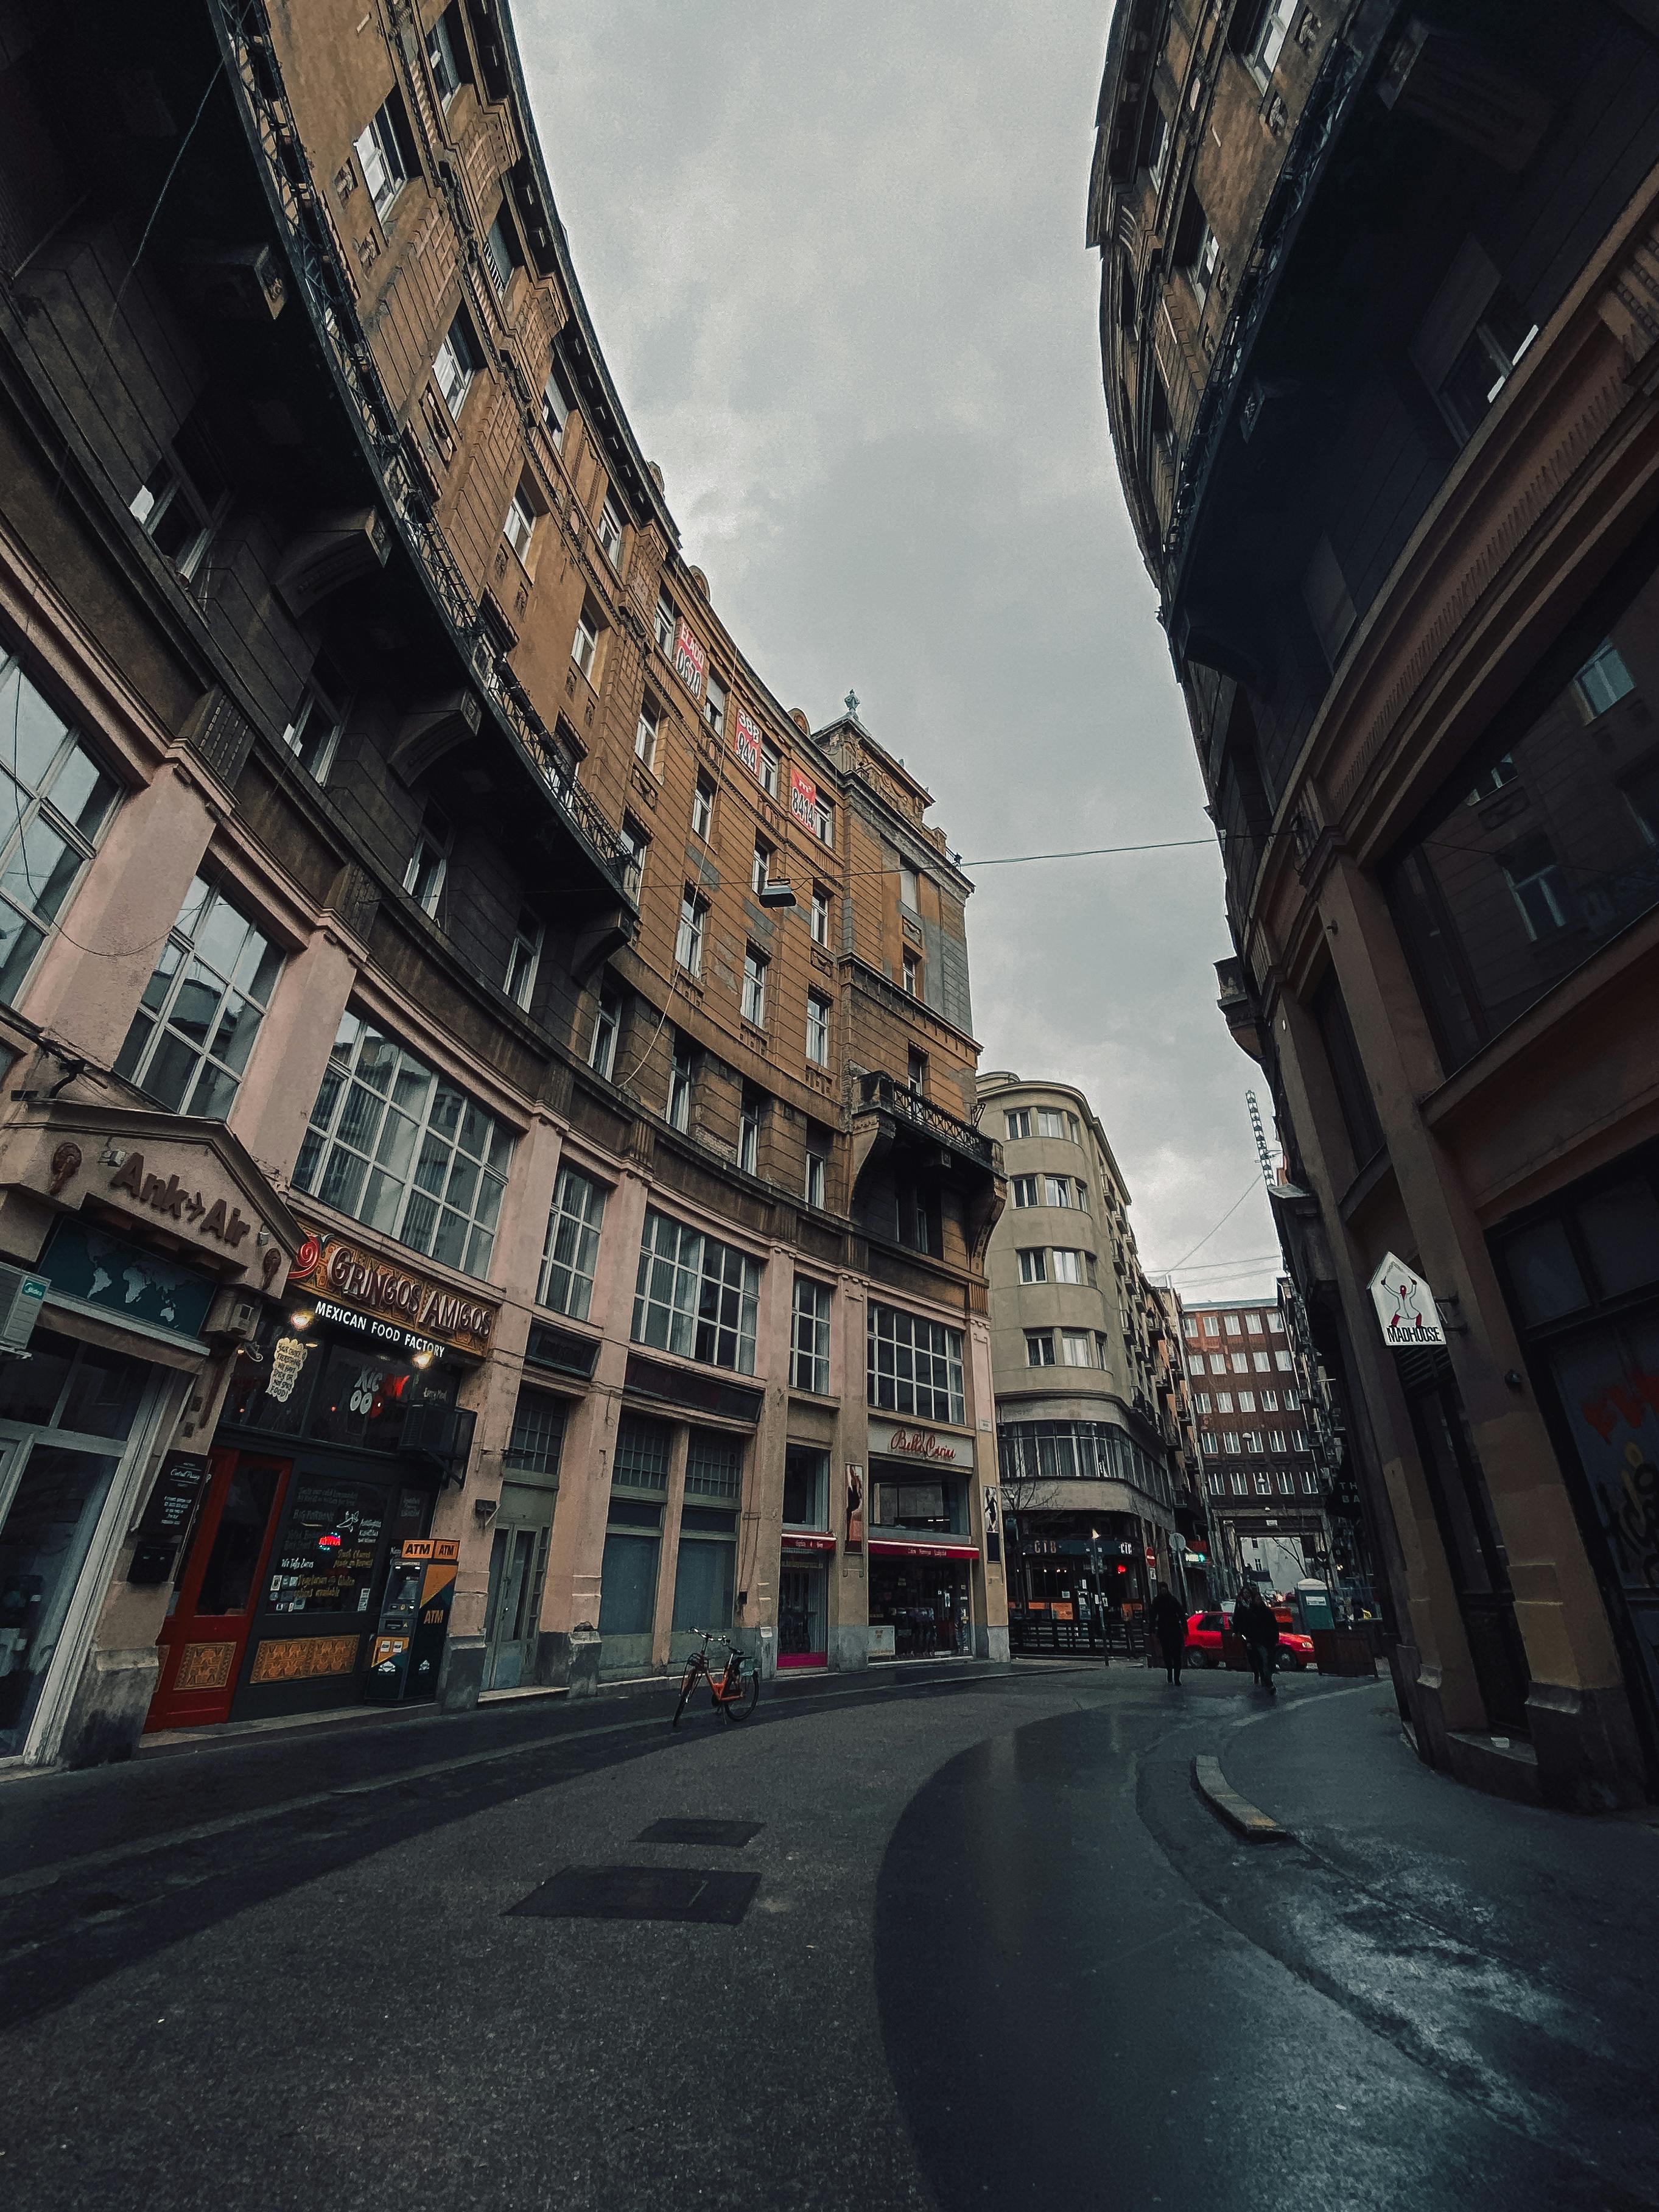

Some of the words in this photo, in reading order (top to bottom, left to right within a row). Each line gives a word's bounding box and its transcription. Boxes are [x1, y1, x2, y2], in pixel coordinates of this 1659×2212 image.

[792, 787, 814, 830] 8414
[200, 1198, 251, 1248] Air
[327, 1246, 421, 1315] GRINGOS
[418, 1290, 493, 1339] AMIGOS
[315, 1301, 367, 1330] MEXICAN
[371, 1321, 400, 1342] FOOD
[404, 1333, 445, 1358] FACTORY
[1386, 1325, 1442, 1343] MADHOUSE
[1339, 1482, 1358, 1490] TH
[1342, 1495, 1361, 1503] BA
[405, 1543, 431, 1555] ATM
[438, 1545, 454, 1556] ATM
[424, 1609, 444, 1624] ATM
